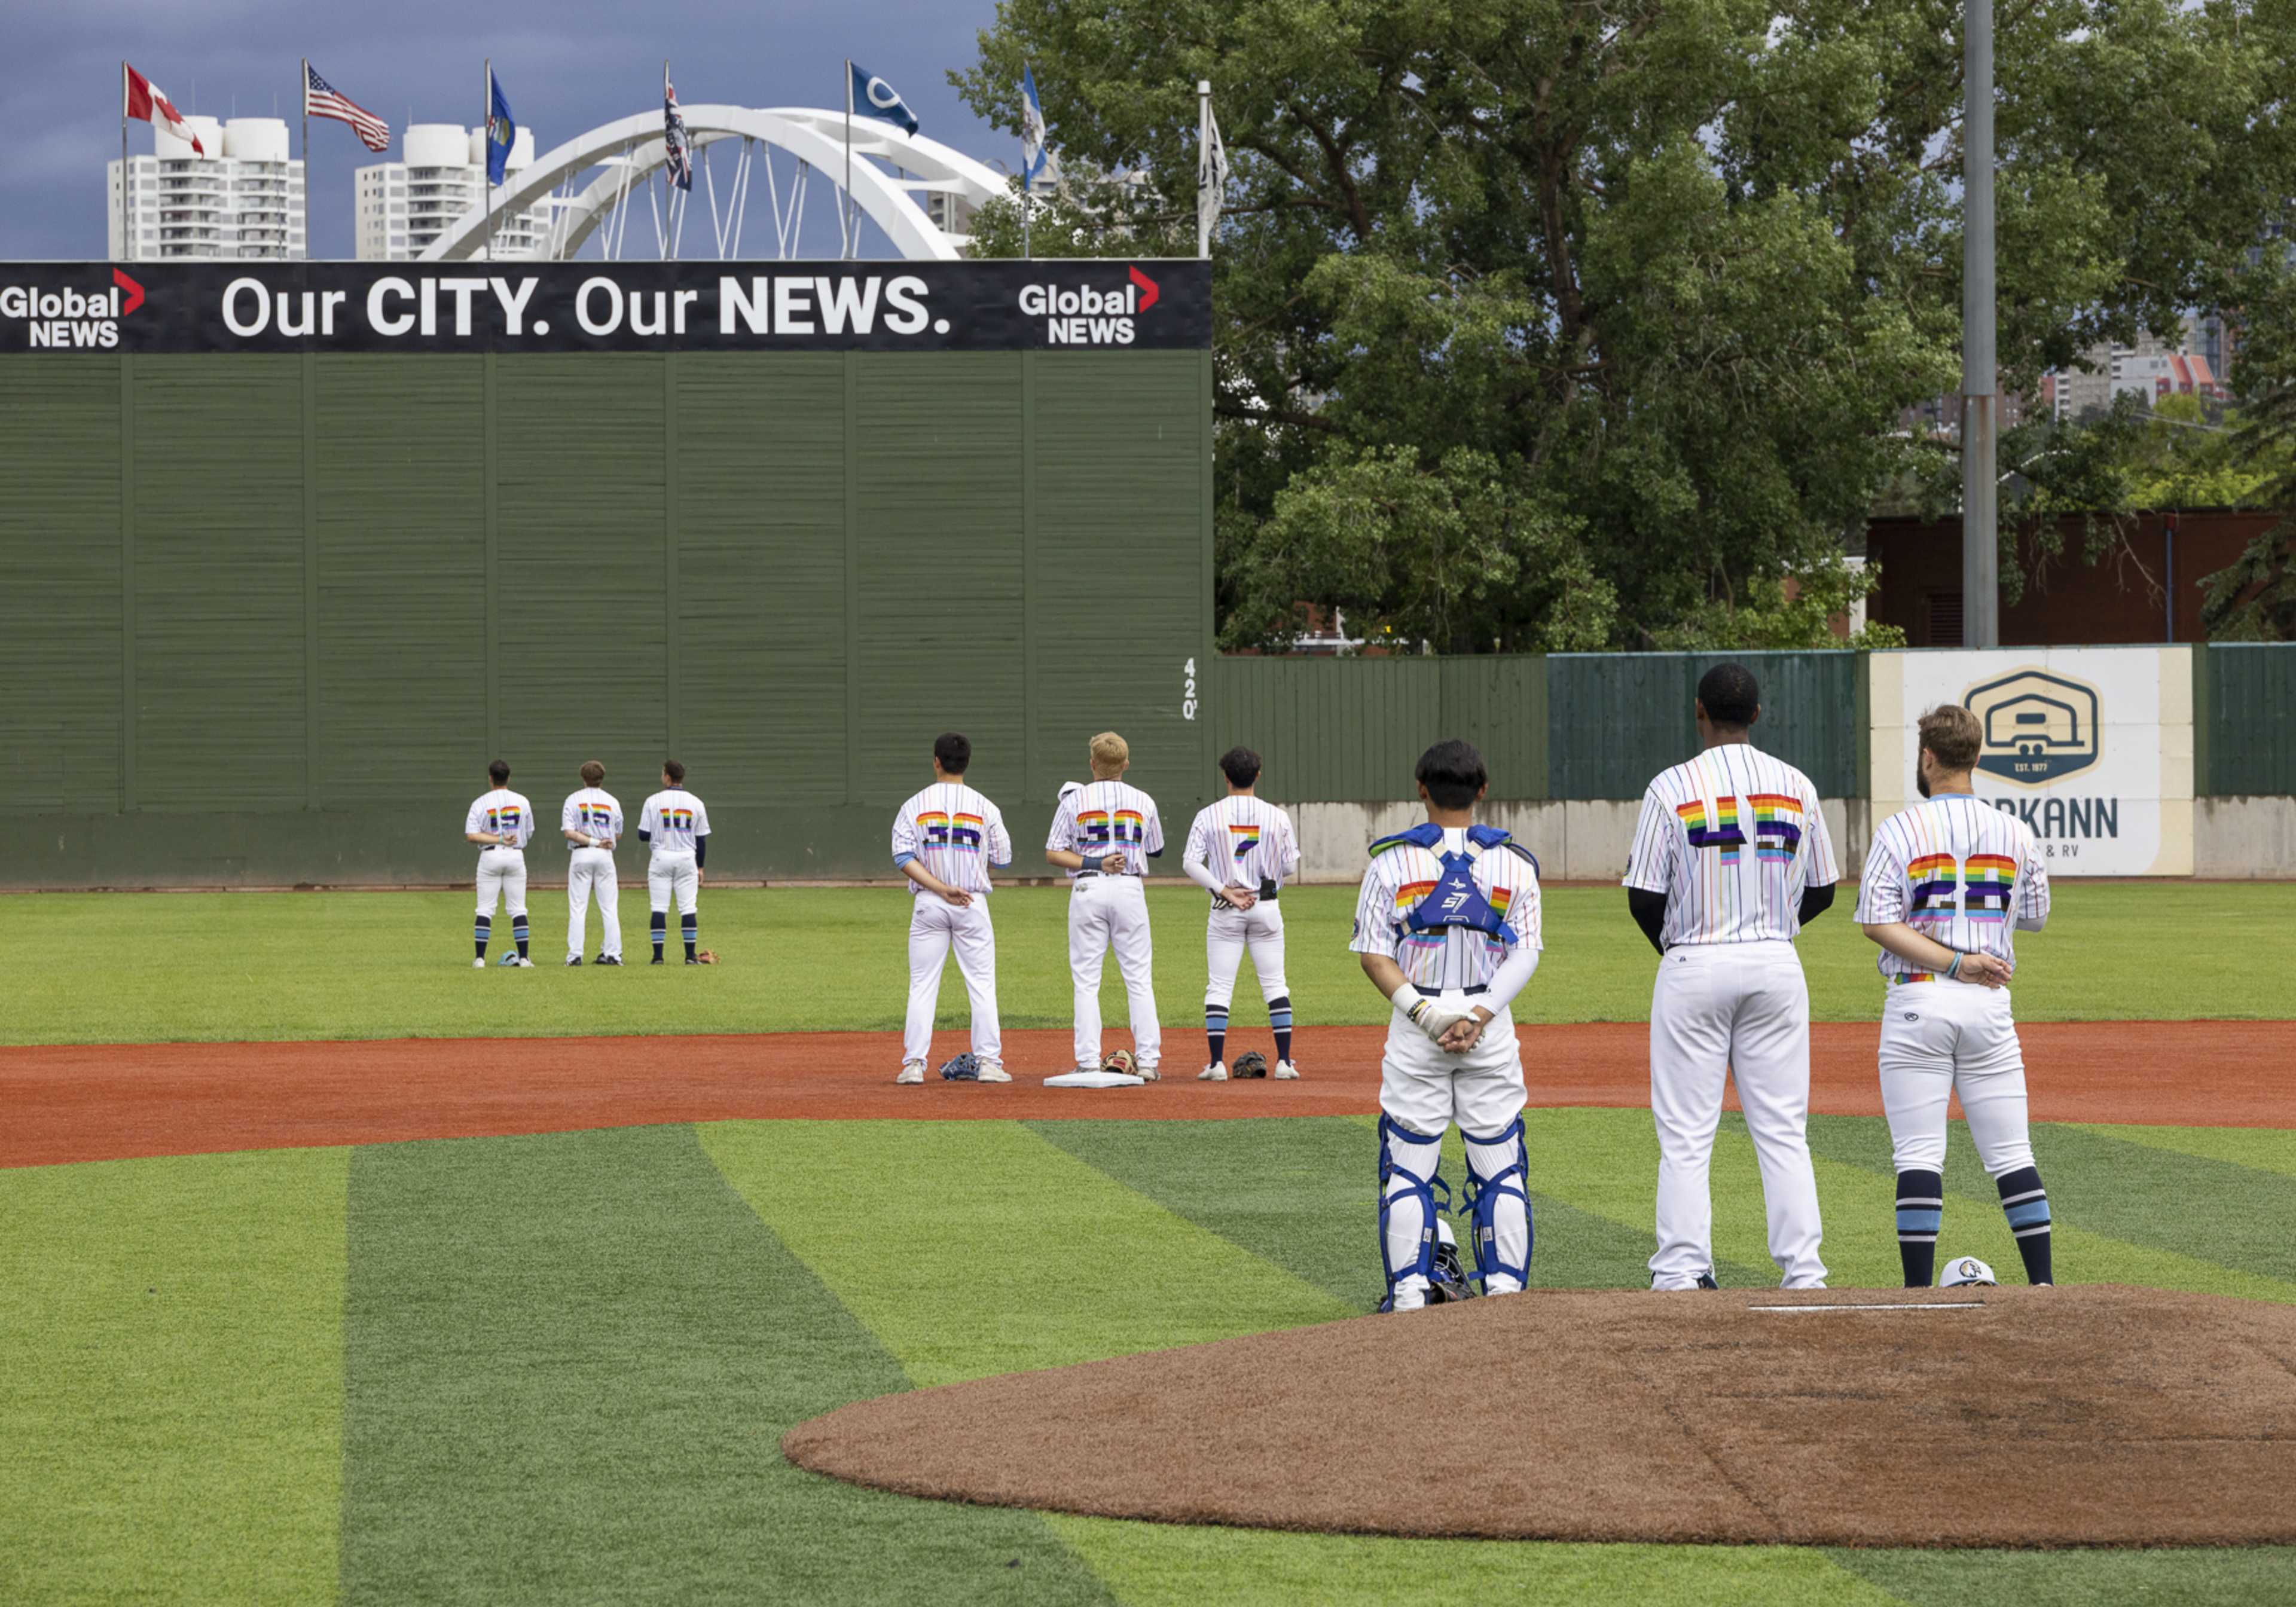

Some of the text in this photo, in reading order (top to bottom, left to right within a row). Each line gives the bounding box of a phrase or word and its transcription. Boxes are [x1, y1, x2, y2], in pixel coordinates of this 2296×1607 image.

[0, 286, 118, 318] Global
[222, 276, 950, 337] Our CITY. Our NEWS.
[1018, 284, 1135, 316] Global
[30, 320, 118, 347] NEWS
[1048, 317, 1135, 344] NEWS
[487, 806, 521, 833] 19
[578, 804, 612, 829] 15
[660, 808, 693, 833] 10
[915, 811, 984, 854] 36
[1076, 809, 1143, 850] 30
[1675, 793, 1804, 866] 45
[1228, 824, 1260, 864] 7
[2045, 844, 2078, 857] & RV
[1907, 853, 2018, 922] 28
